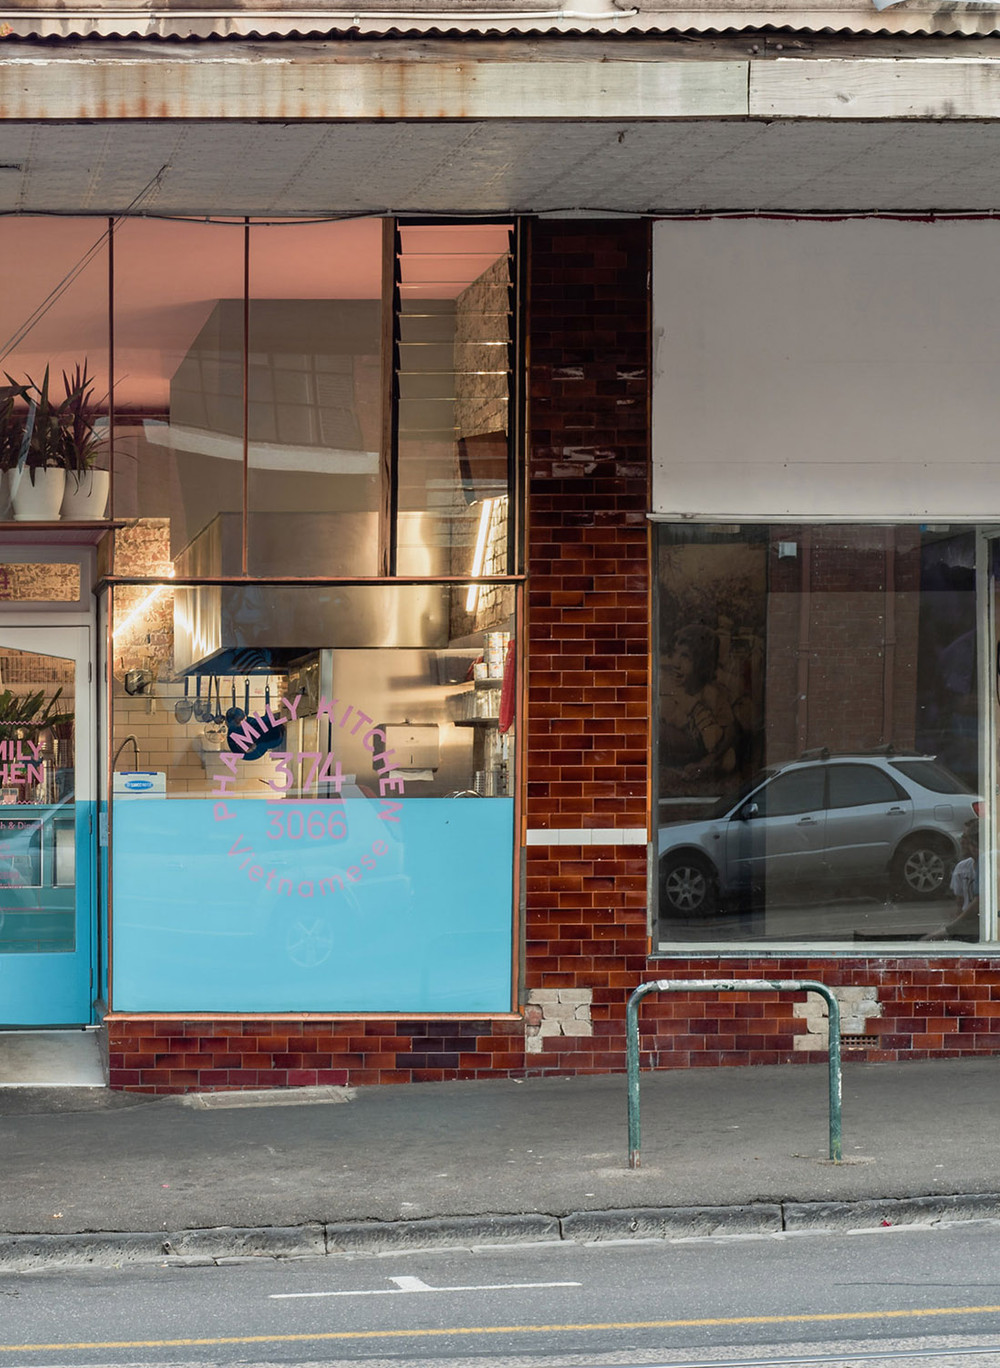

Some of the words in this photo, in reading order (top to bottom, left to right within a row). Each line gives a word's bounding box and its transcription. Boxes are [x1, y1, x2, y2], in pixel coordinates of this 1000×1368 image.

[212, 695, 302, 822] PHAMILY
[317, 696, 406, 823] KITCHEN
[268, 752, 346, 794] 374
[8, 822, 15, 830] &
[266, 810, 348, 841] 3066
[228, 834, 388, 898] Vietnamese
